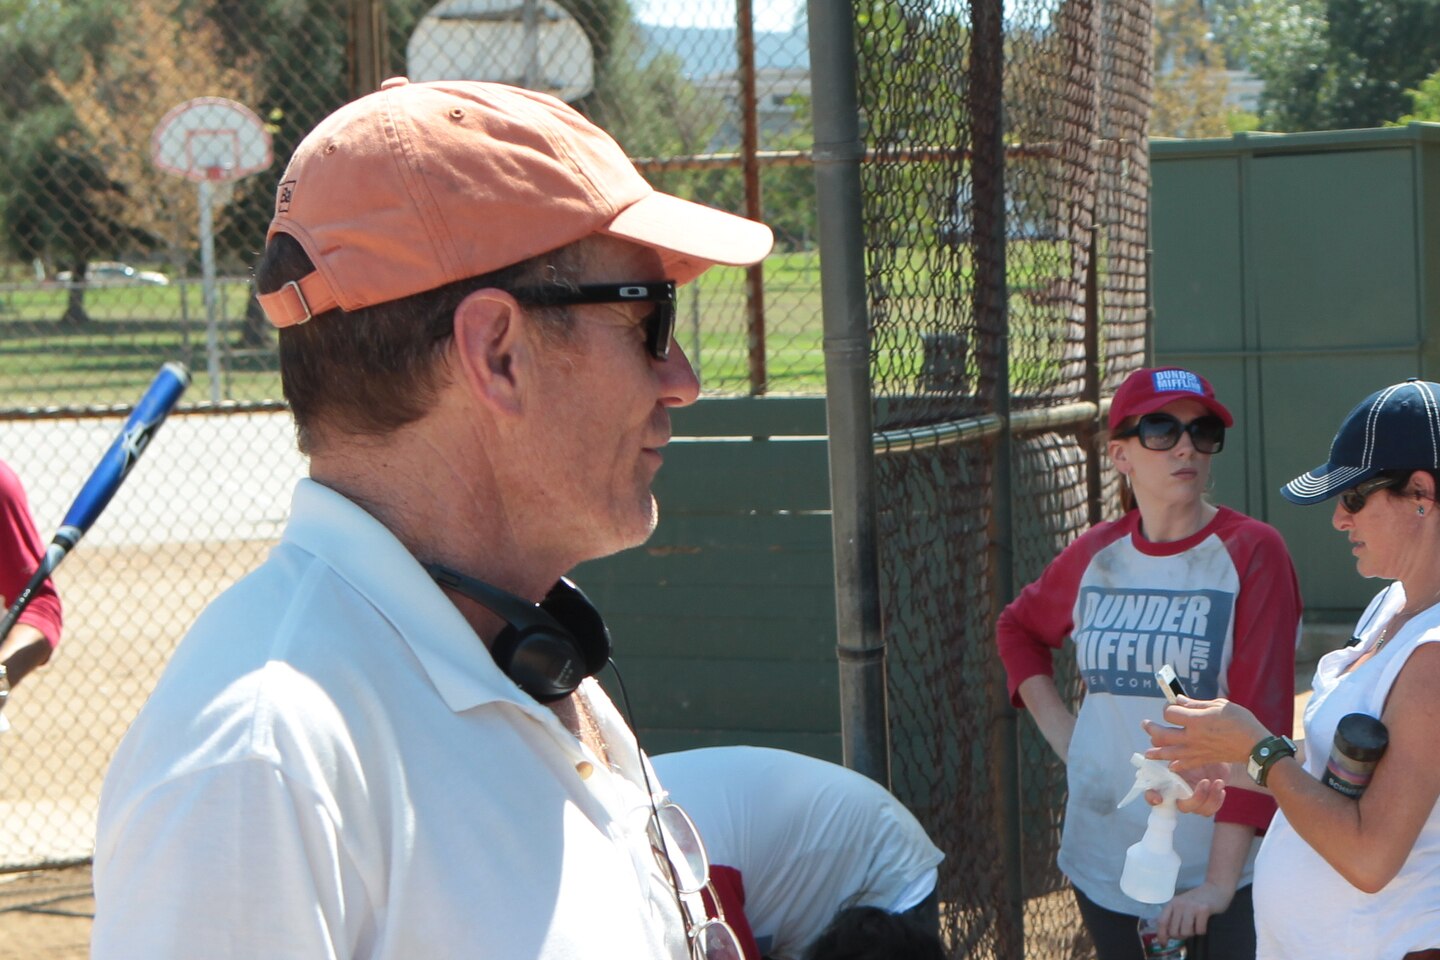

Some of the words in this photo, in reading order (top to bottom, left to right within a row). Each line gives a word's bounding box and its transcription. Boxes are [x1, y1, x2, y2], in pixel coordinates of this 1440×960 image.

[1082, 592, 1211, 636] DUNDER
[1191, 641, 1210, 670] INC
[1116, 677, 1198, 694] COMY
